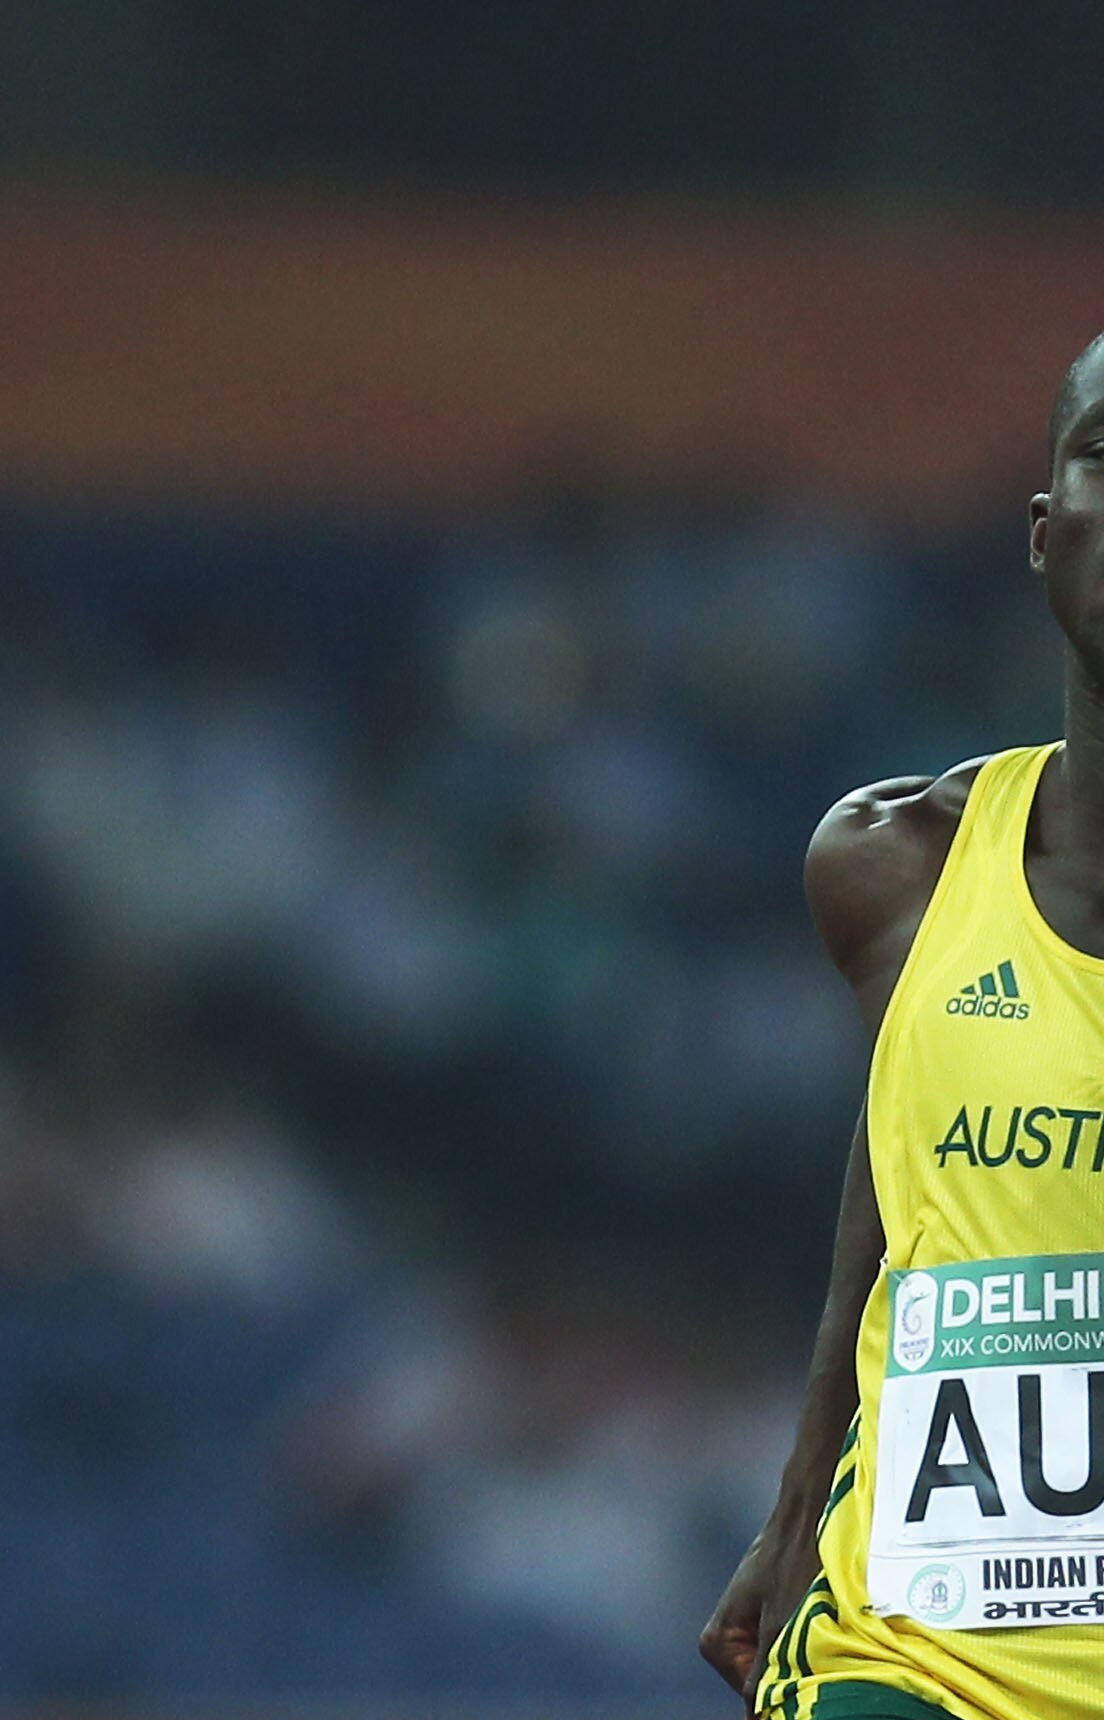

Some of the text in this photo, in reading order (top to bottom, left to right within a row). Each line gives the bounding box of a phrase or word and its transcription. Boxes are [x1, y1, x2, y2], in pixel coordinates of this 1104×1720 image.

[946, 995, 1030, 1020] adidas
[941, 1269, 1100, 1329] DELHI
[940, 1336, 975, 1359] XIX
[982, 1556, 1087, 1592] INDIAN
